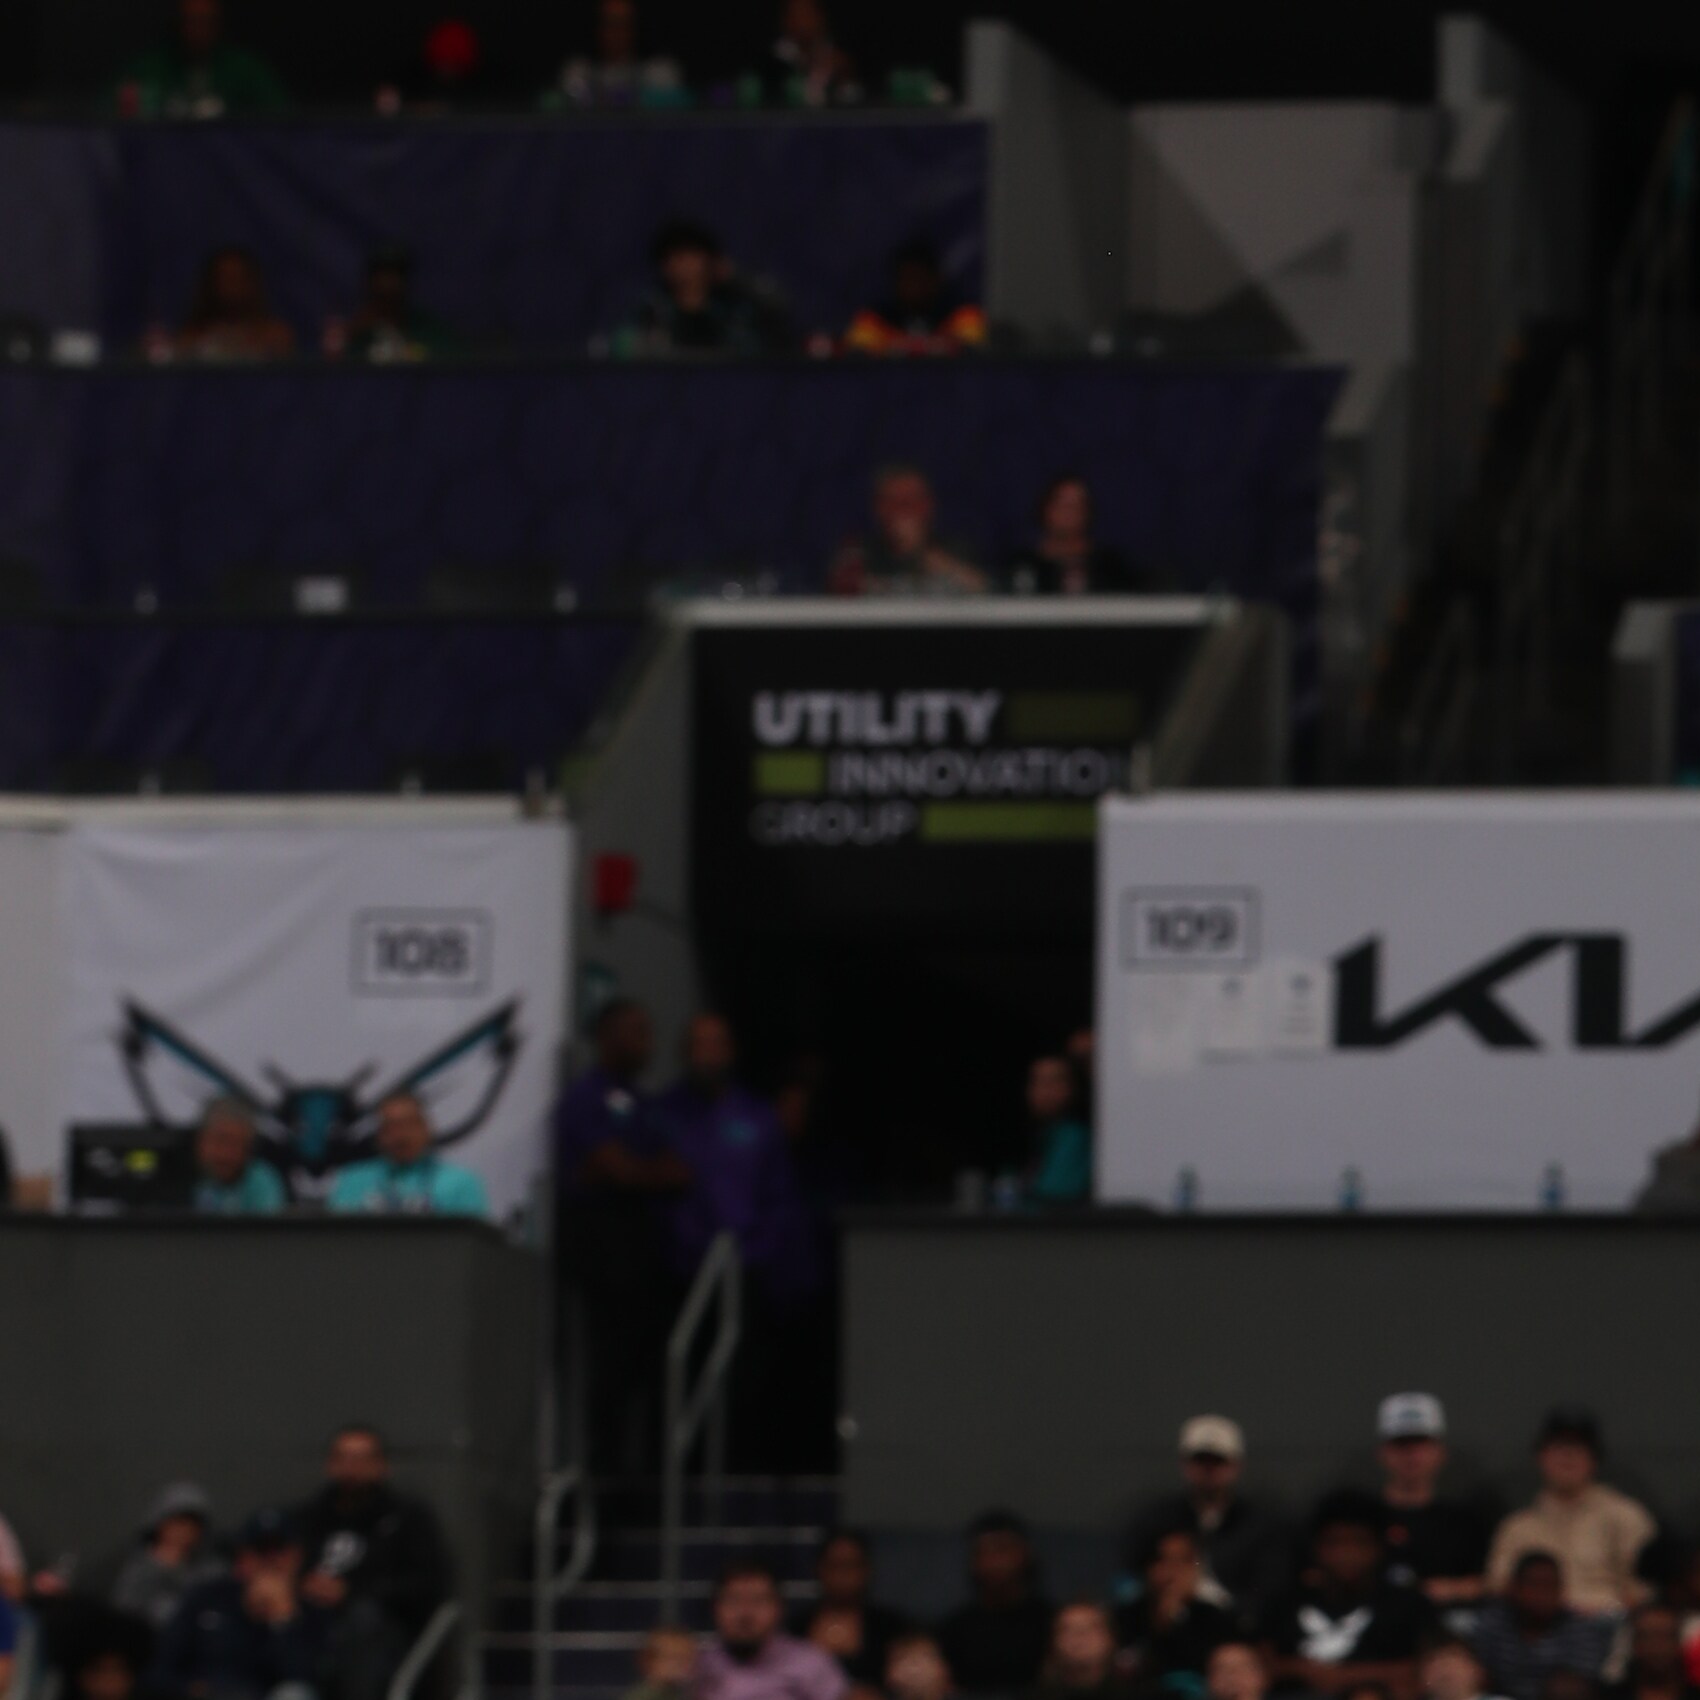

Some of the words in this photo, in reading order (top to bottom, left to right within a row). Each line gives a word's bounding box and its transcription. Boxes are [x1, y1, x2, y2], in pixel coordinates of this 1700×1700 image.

[754, 690, 1000, 745] UTILITY
[750, 802, 917, 845] GROUP
[375, 927, 471, 976] 108
[1147, 906, 1236, 951] 109
